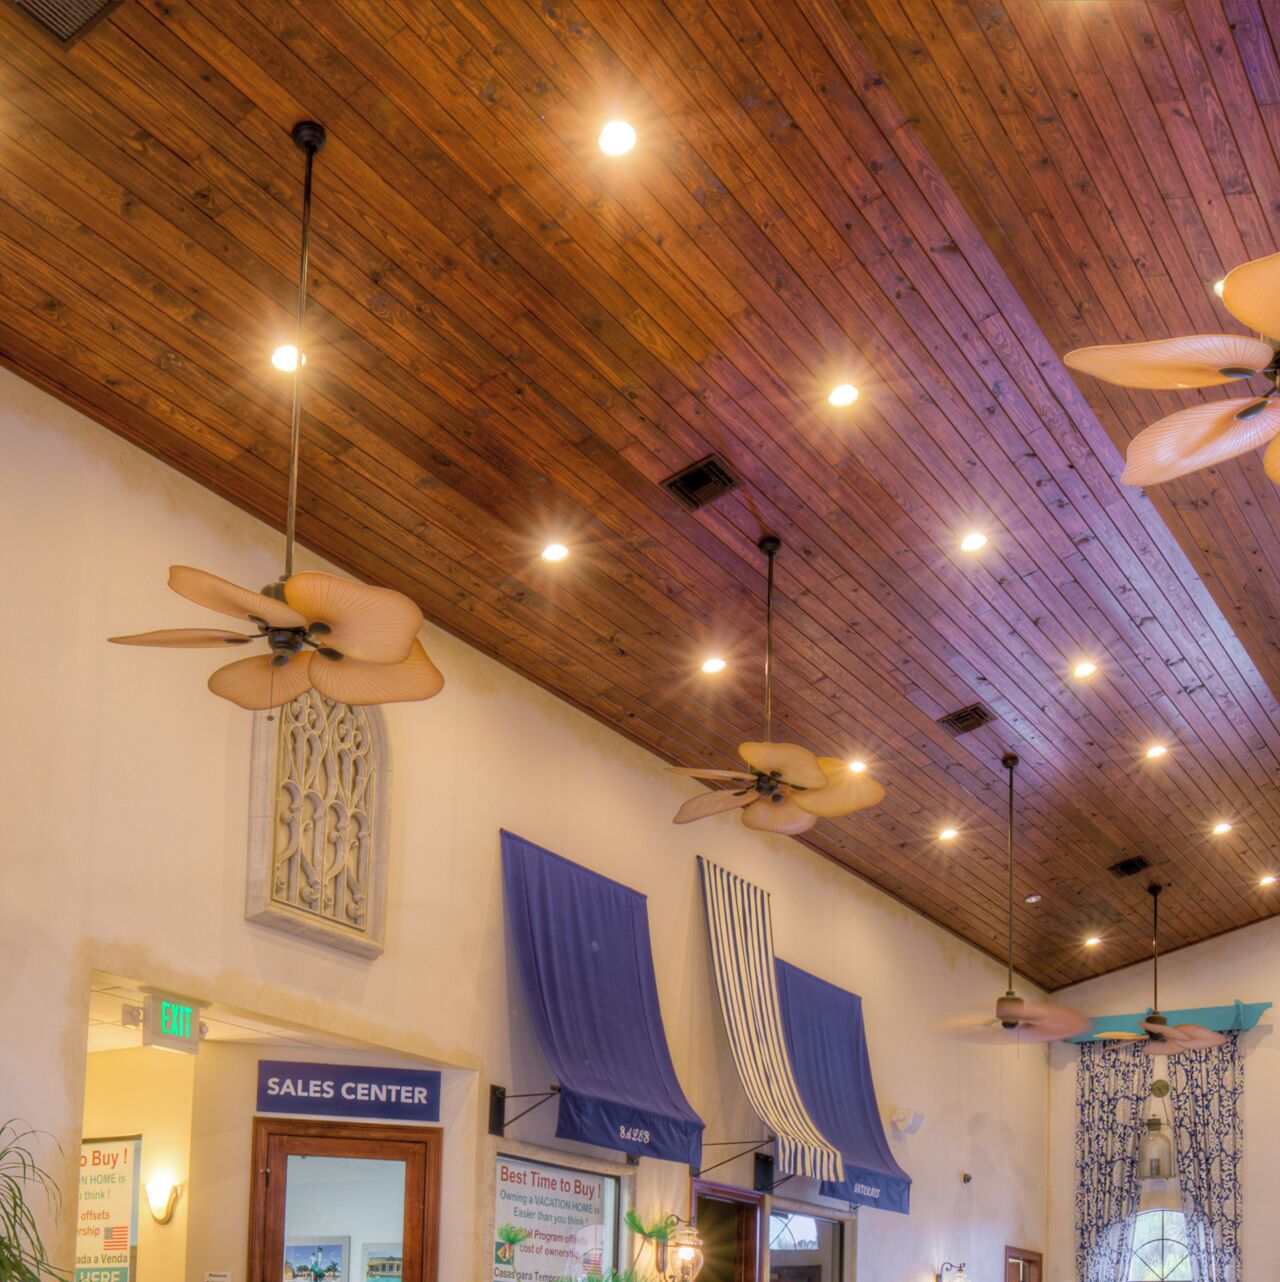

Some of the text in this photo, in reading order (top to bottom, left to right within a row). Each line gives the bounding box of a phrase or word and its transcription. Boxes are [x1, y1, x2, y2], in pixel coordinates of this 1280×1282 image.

[160, 1001, 193, 1039] EXIT
[266, 1077, 428, 1104] SALES CENTER
[619, 1125, 650, 1144] SALES
[92, 1150, 119, 1169] Buy
[123, 1147, 127, 1164] !
[90, 1173, 116, 1185] HOME
[118, 1173, 126, 1184] is
[500, 1165, 527, 1186] Best
[530, 1170, 557, 1191] Time
[560, 1177, 571, 1193] to
[574, 1179, 595, 1200] Buy
[84, 1189, 105, 1200] think
[500, 1189, 527, 1205] Owning
[534, 1195, 571, 1210] VACATION
[572, 1203, 593, 1214] HOME
[80, 1210, 110, 1221] offsets
[513, 1206, 536, 1219] Easier
[537, 1211, 553, 1221] than
[554, 1215, 567, 1225] you
[567, 1215, 584, 1226] think
[534, 1229, 564, 1243] Program
[519, 1244, 534, 1254] cost
[536, 1245, 544, 1255] of
[101, 1252, 128, 1265] Venda
[494, 1266, 516, 1279] Casas
